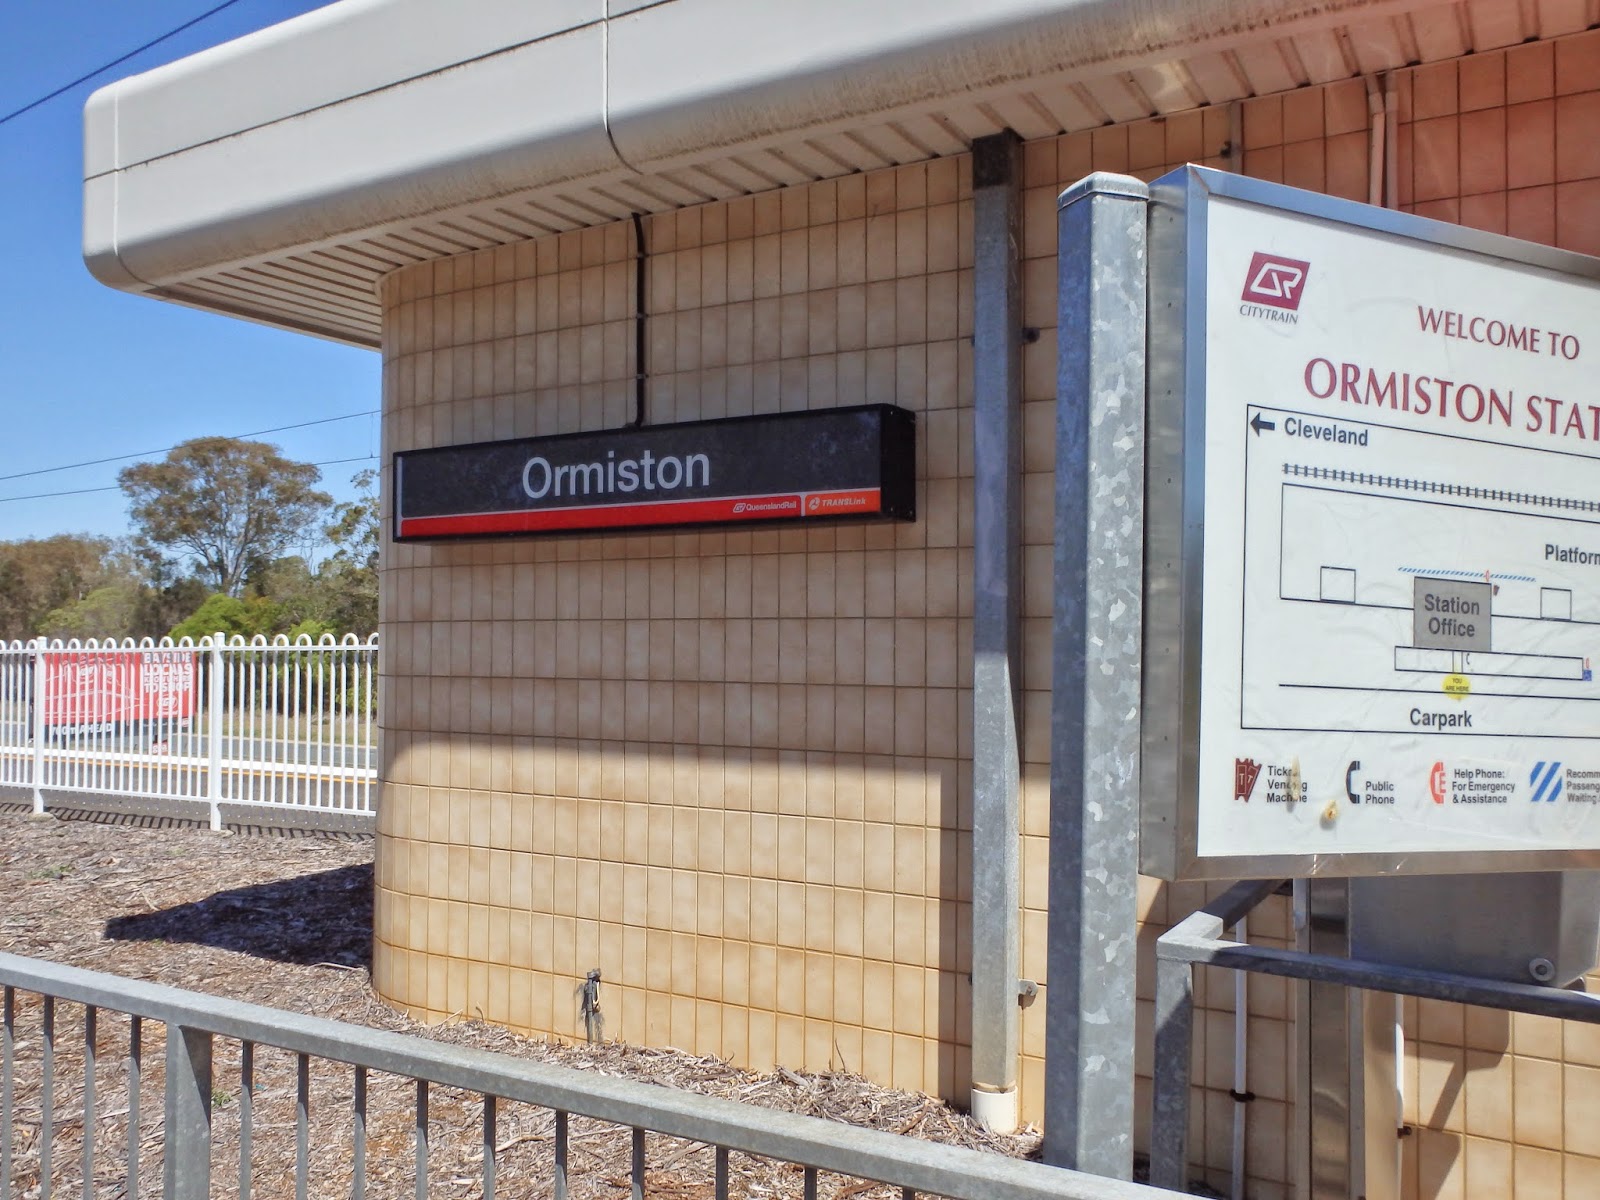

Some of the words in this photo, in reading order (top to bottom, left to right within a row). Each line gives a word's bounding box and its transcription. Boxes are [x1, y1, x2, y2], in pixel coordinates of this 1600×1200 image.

[1239, 304, 1299, 325] CITYTRAIN
[1417, 305, 1540, 354] WELCOME
[1548, 331, 1580, 361] TO
[1304, 357, 1513, 428] ORMISTON
[1284, 417, 1369, 447] Cleveland
[522, 449, 710, 499] Ormiston
[1424, 593, 1481, 616] Station
[1428, 617, 1476, 638] Office
[1452, 677, 1463, 685] YOU
[1456, 685, 1469, 693] HERE
[1409, 708, 1473, 731] Carpark
[1267, 765, 1297, 777] Ticke
[1454, 769, 1474, 781] Help
[1475, 769, 1505, 780] Phone:
[1267, 779, 1308, 793] Veng
[1365, 781, 1394, 792] Public
[1452, 781, 1467, 791] For
[1468, 781, 1516, 793] Emergency
[1266, 793, 1308, 803] Mache
[1365, 794, 1395, 805] Phone
[1452, 794, 1459, 804] &
[1460, 793, 1508, 804] Assistance
[1567, 793, 1597, 805] Waiting
